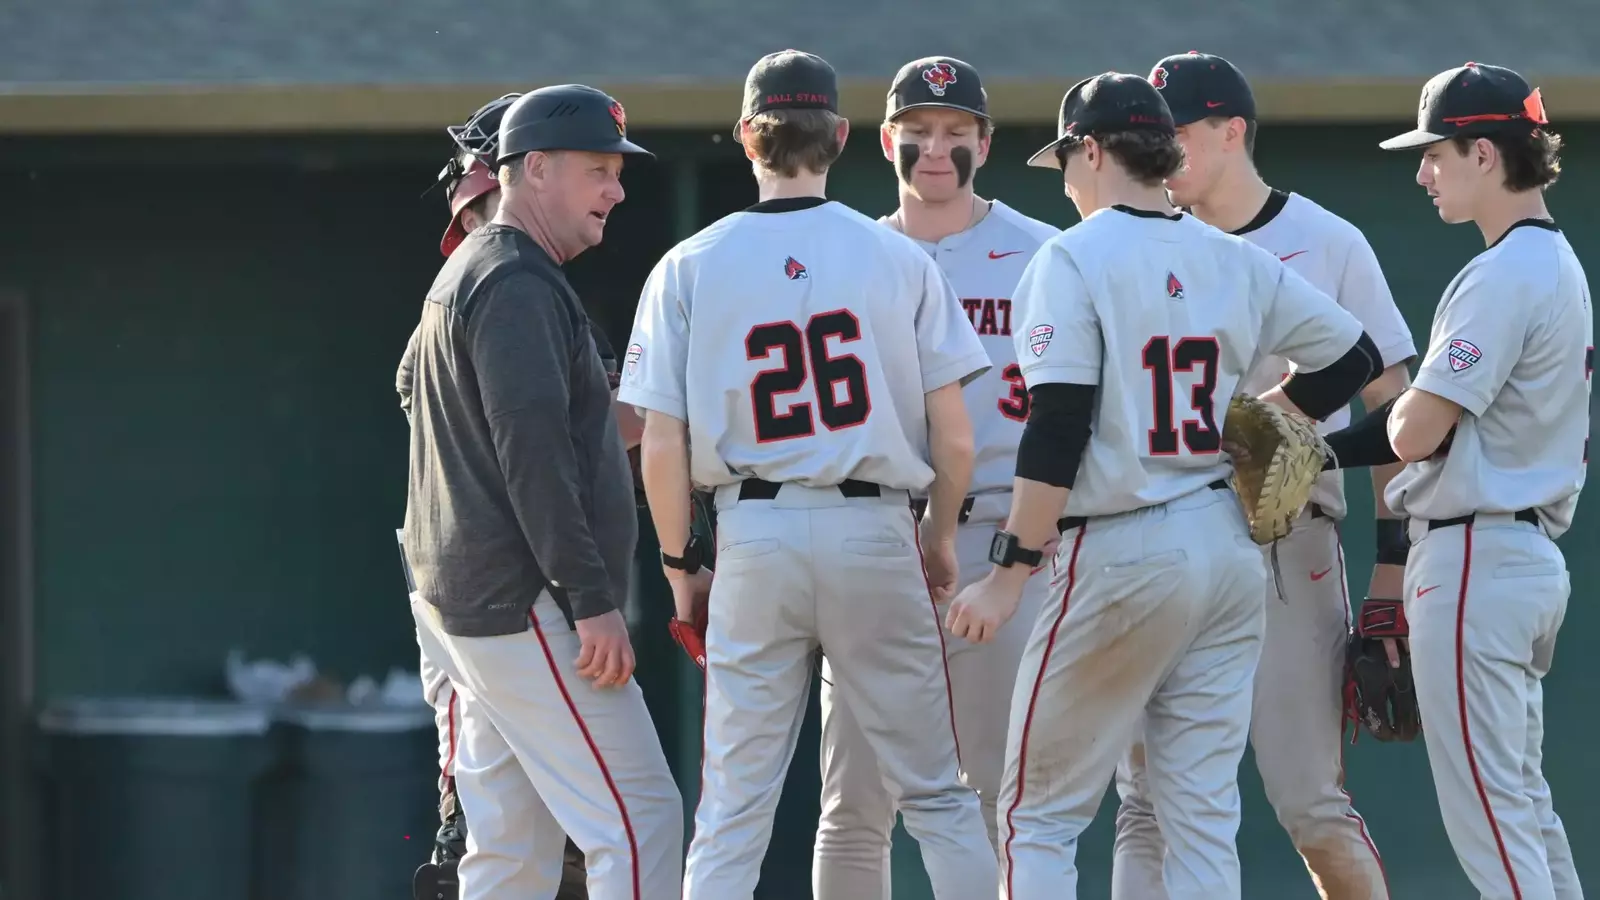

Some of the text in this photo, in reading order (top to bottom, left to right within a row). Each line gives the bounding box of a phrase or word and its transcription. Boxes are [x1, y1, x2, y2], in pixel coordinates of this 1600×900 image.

[766, 93, 829, 104] BALL STATE
[959, 298, 1012, 336] TAT
[1449, 346, 1478, 364] MAC
[745, 308, 872, 444] 26
[1142, 335, 1221, 456] 13
